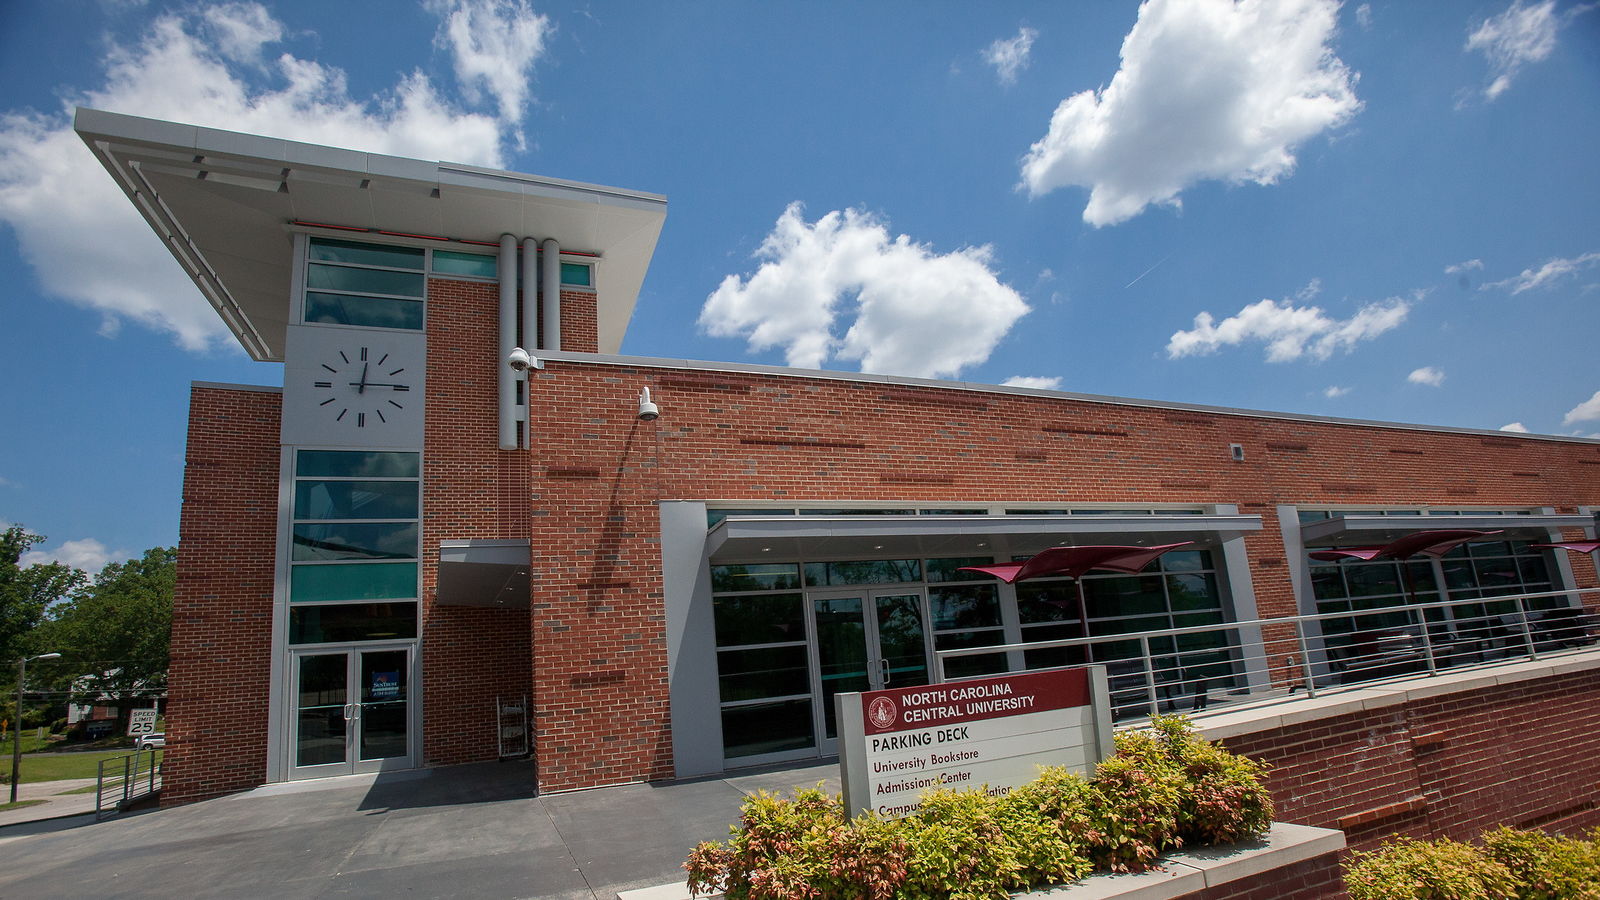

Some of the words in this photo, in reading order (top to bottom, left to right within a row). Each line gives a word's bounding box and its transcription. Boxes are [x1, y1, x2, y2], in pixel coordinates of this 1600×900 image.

[902, 690, 946, 707] NORTH
[950, 683, 1012, 701] CAROLINA
[904, 705, 963, 723] CENTRAL
[966, 695, 1035, 715] UNIVERSITY
[131, 722, 153, 733] 25
[872, 732, 932, 752] PARKING
[937, 726, 969, 743] DECK
[874, 757, 926, 773] University
[931, 750, 979, 765] Bookstore
[940, 772, 971, 784] Center
[879, 802, 923, 816] Campus
